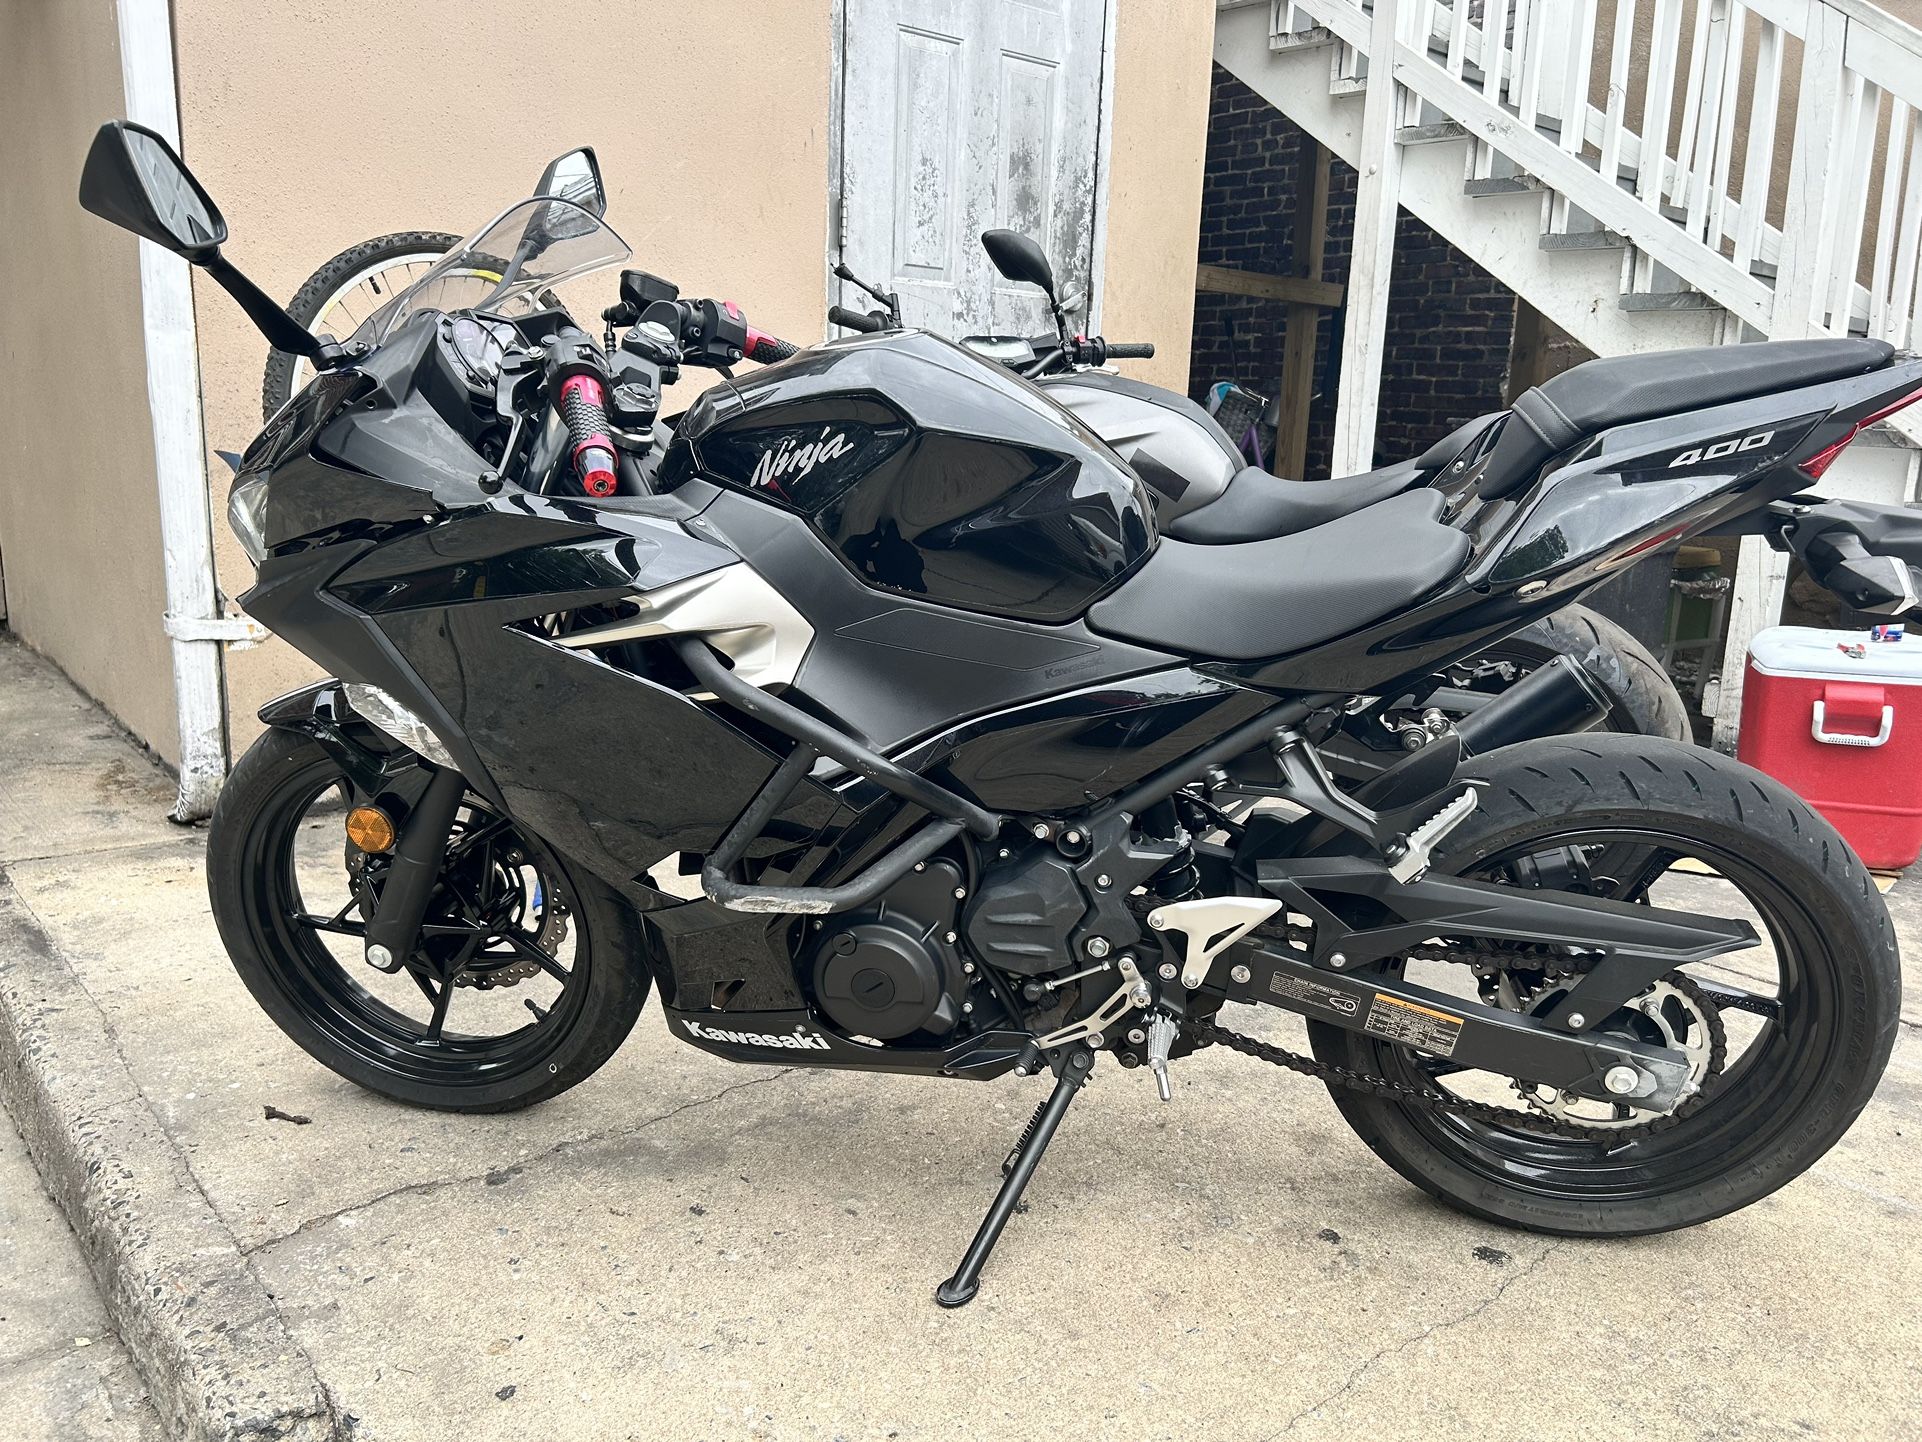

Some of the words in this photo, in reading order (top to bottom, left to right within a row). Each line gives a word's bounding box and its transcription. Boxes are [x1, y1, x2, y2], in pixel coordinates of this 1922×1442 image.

[750, 426, 854, 487] Ninja
[1668, 431, 1775, 468] 400
[682, 1019, 832, 1050] Kawasaki
